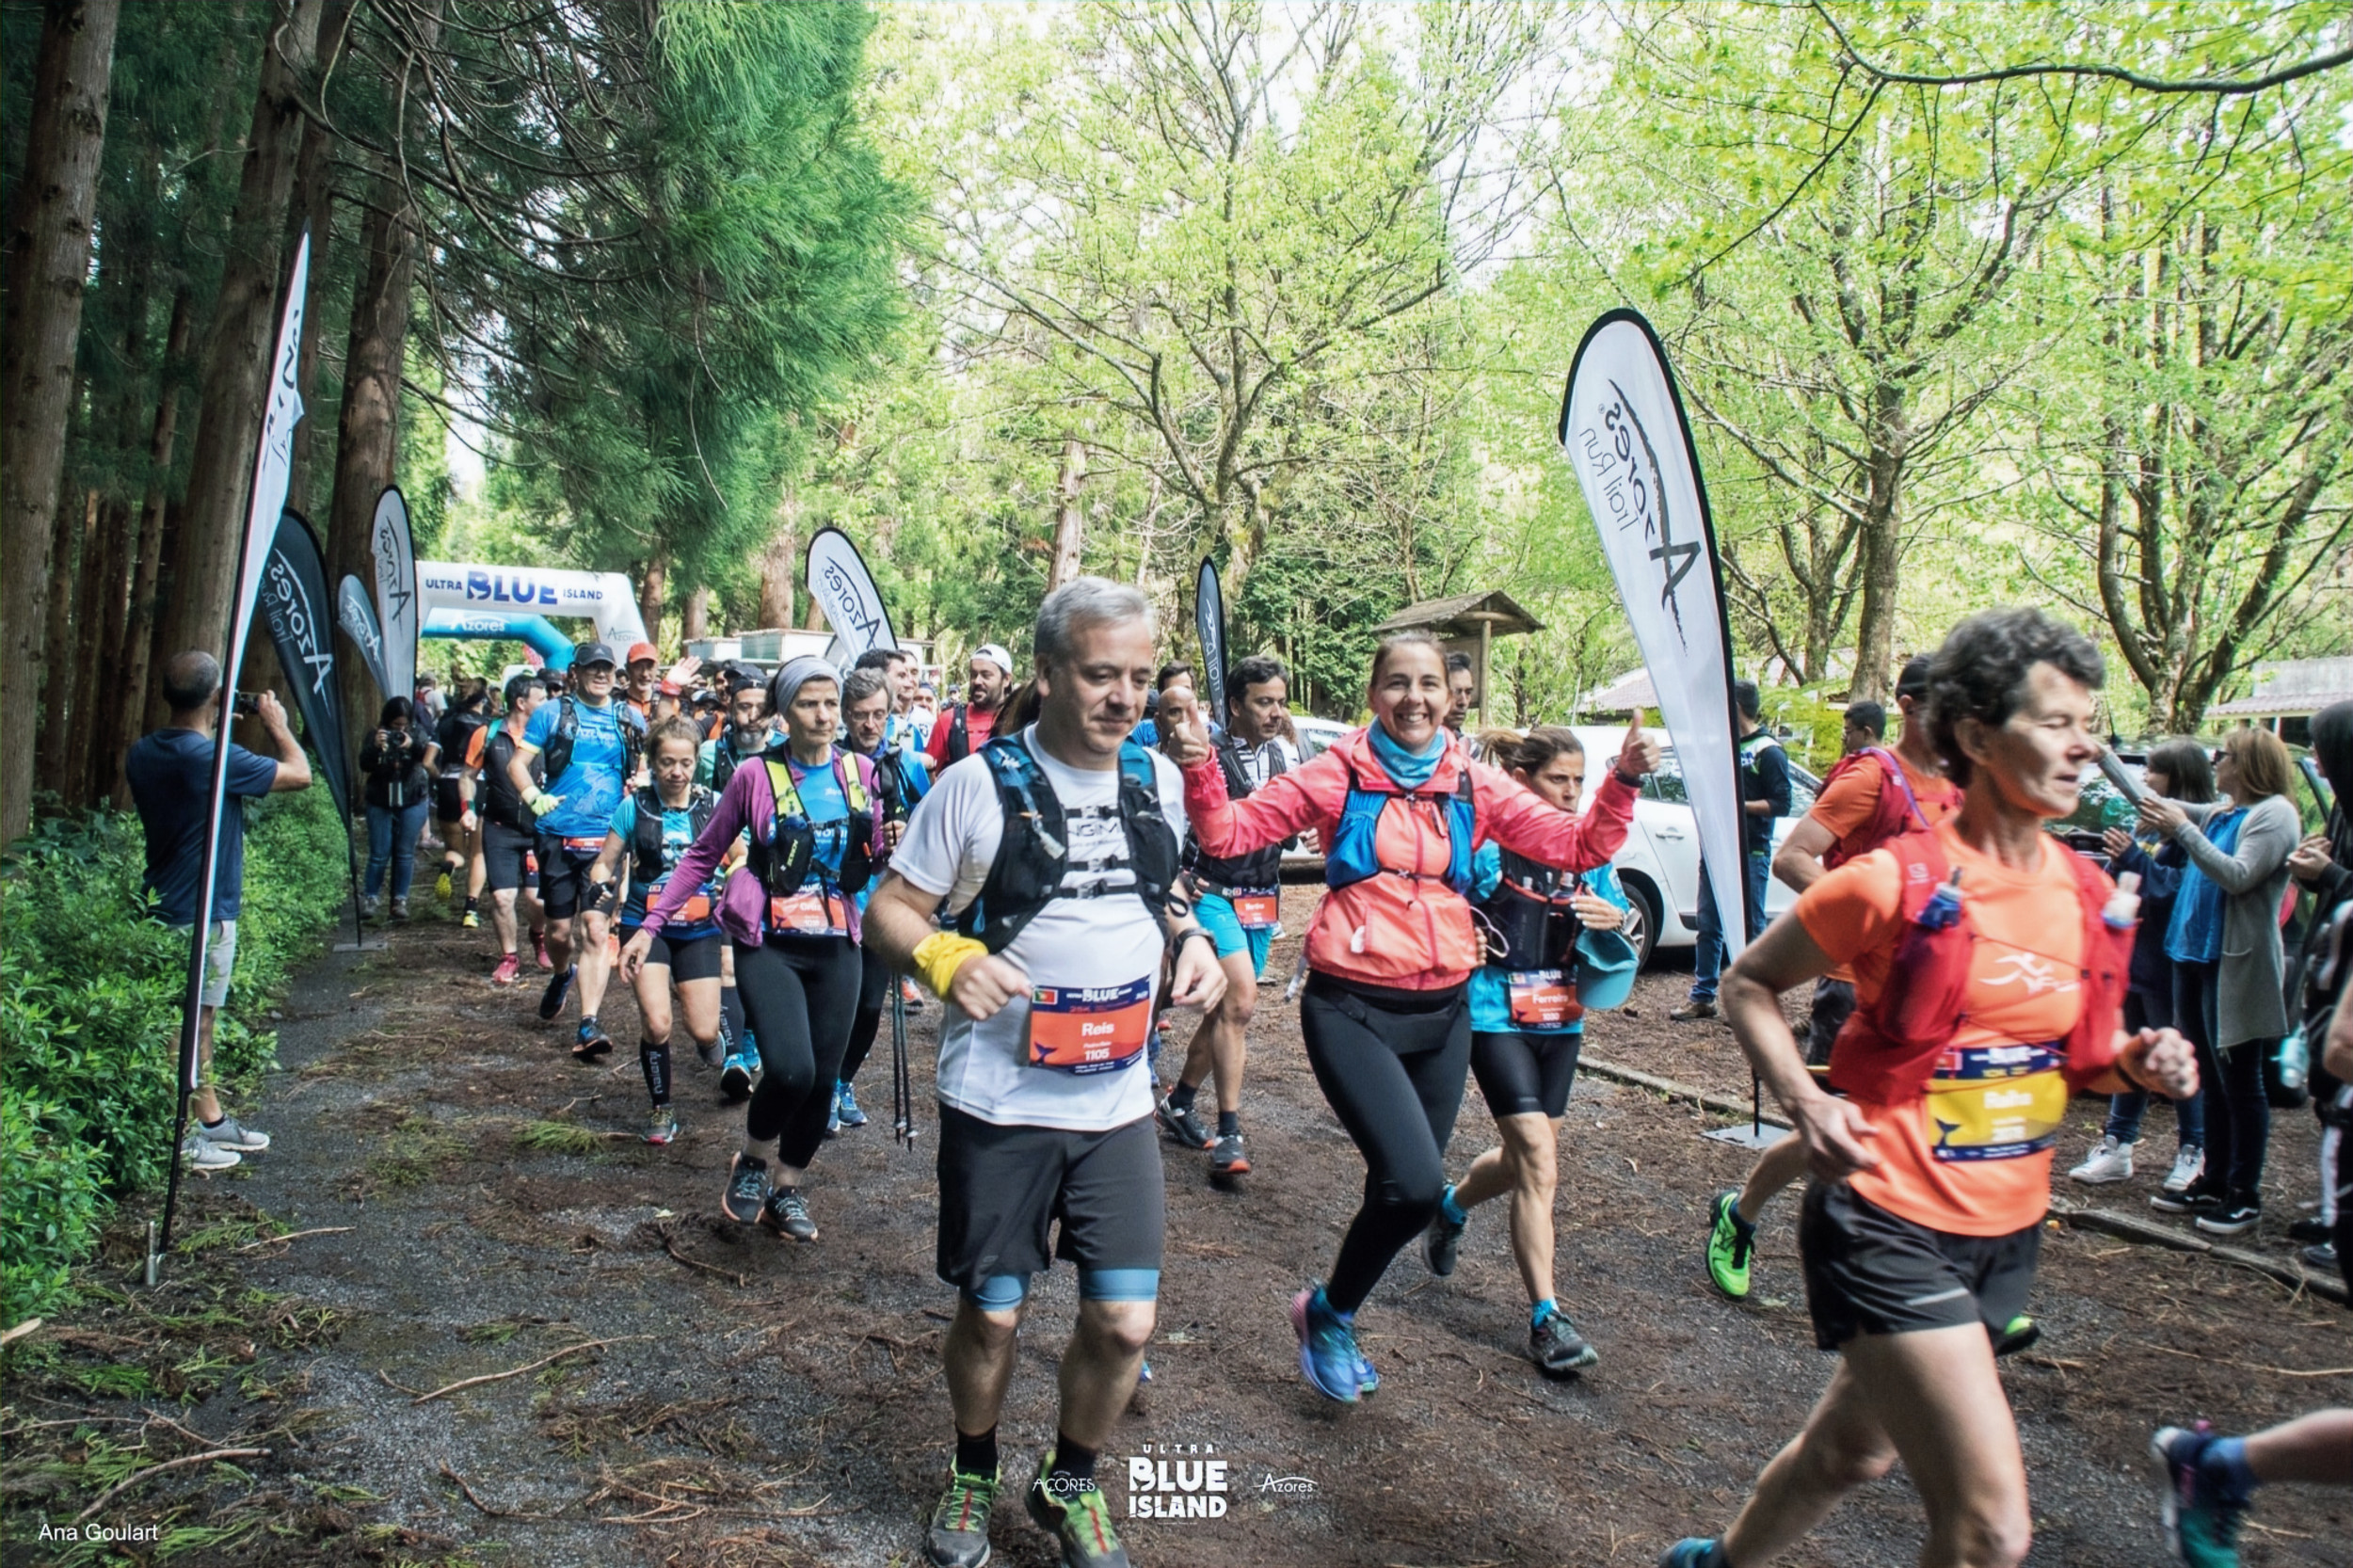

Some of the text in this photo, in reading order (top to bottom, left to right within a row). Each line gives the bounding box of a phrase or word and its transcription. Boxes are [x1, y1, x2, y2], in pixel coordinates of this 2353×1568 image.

[425, 570, 603, 605] ULTRA BLUE ISLAND
[450, 611, 506, 632] Azores
[1082, 987, 1120, 1002] BLUE
[1082, 1021, 1115, 1037] Reis
[1084, 1048, 1111, 1062] 1105
